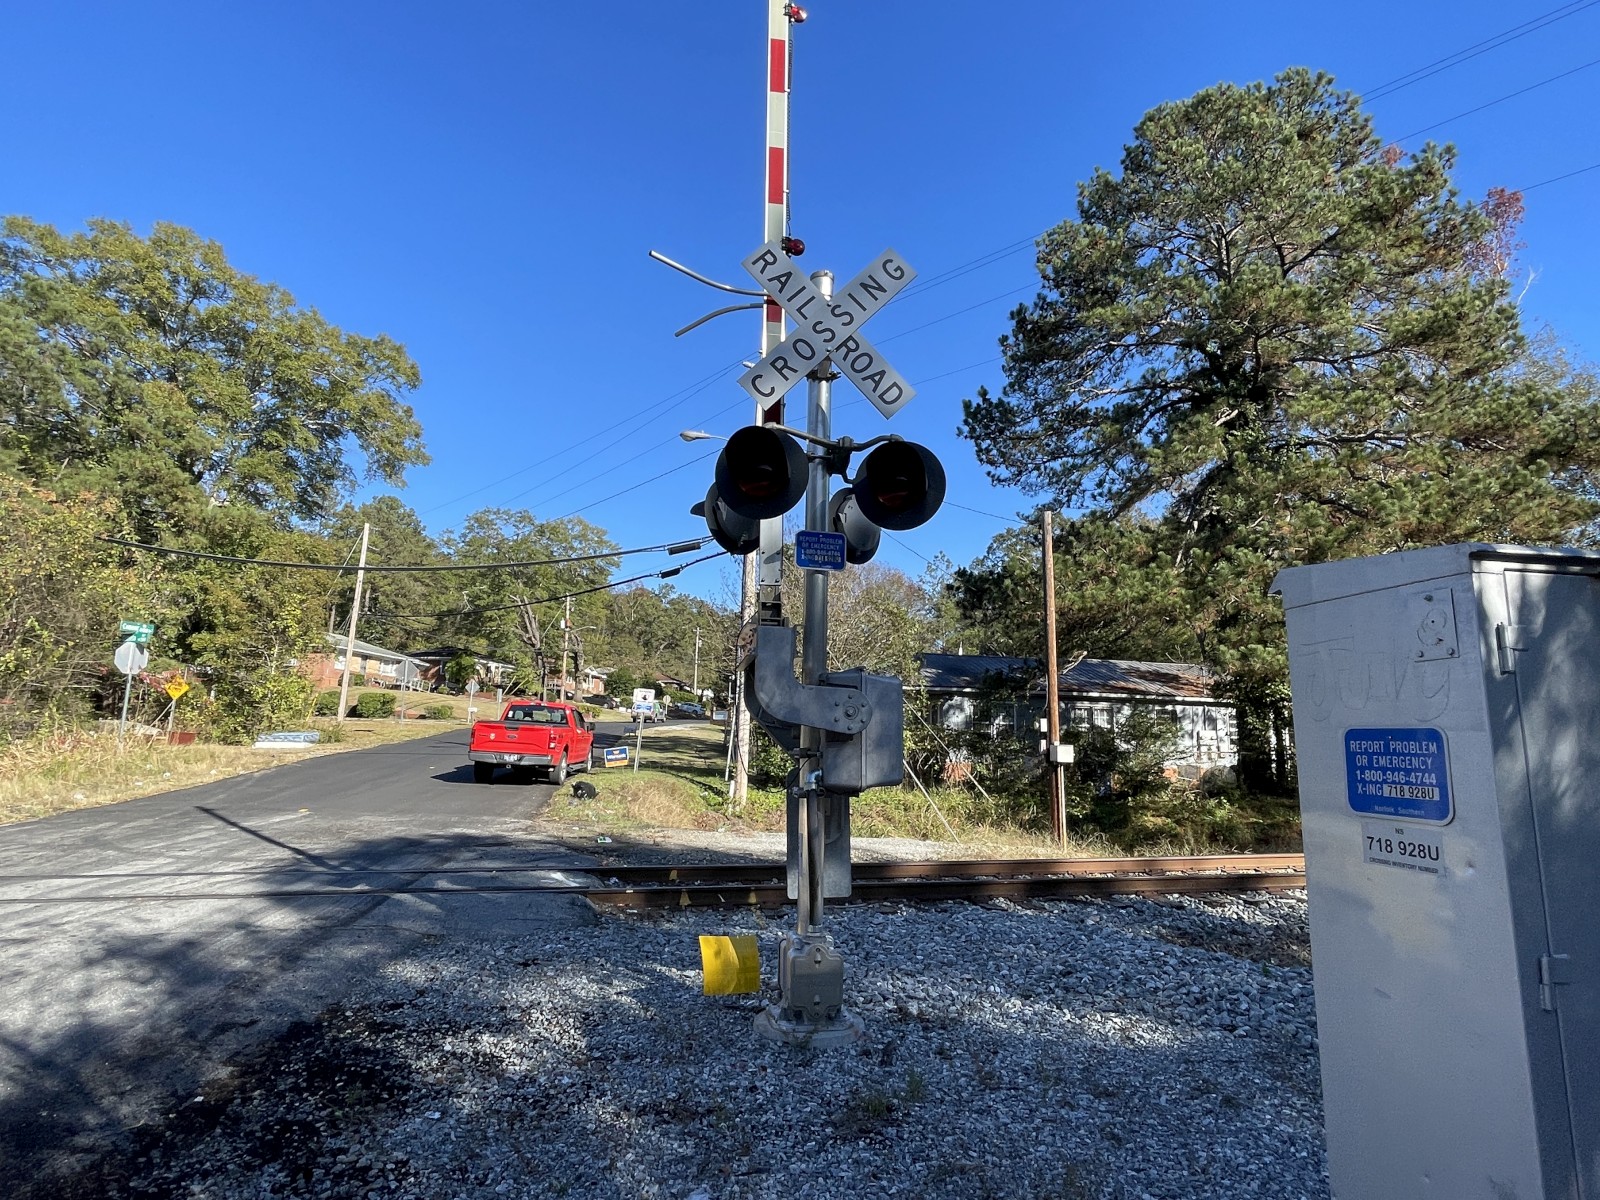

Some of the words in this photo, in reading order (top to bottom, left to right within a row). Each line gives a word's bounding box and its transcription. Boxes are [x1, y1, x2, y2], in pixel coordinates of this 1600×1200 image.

[751, 258, 905, 398] CROSSING
[752, 249, 816, 320] RAIL
[835, 335, 904, 405] ROAD
[1350, 741, 1385, 753] REPORT
[1389, 741, 1438, 754] PROBLEM
[1356, 755, 1368, 767] OR
[1372, 755, 1433, 769] EMERGENCY
[1356, 769, 1437, 785] 1-800-946-4744
[1357, 783, 1382, 796] X-ING
[1387, 785, 1405, 797] 718
[1408, 786, 1435, 800] 928U
[1366, 836, 1393, 853] 718
[1398, 841, 1439, 861] 928U
